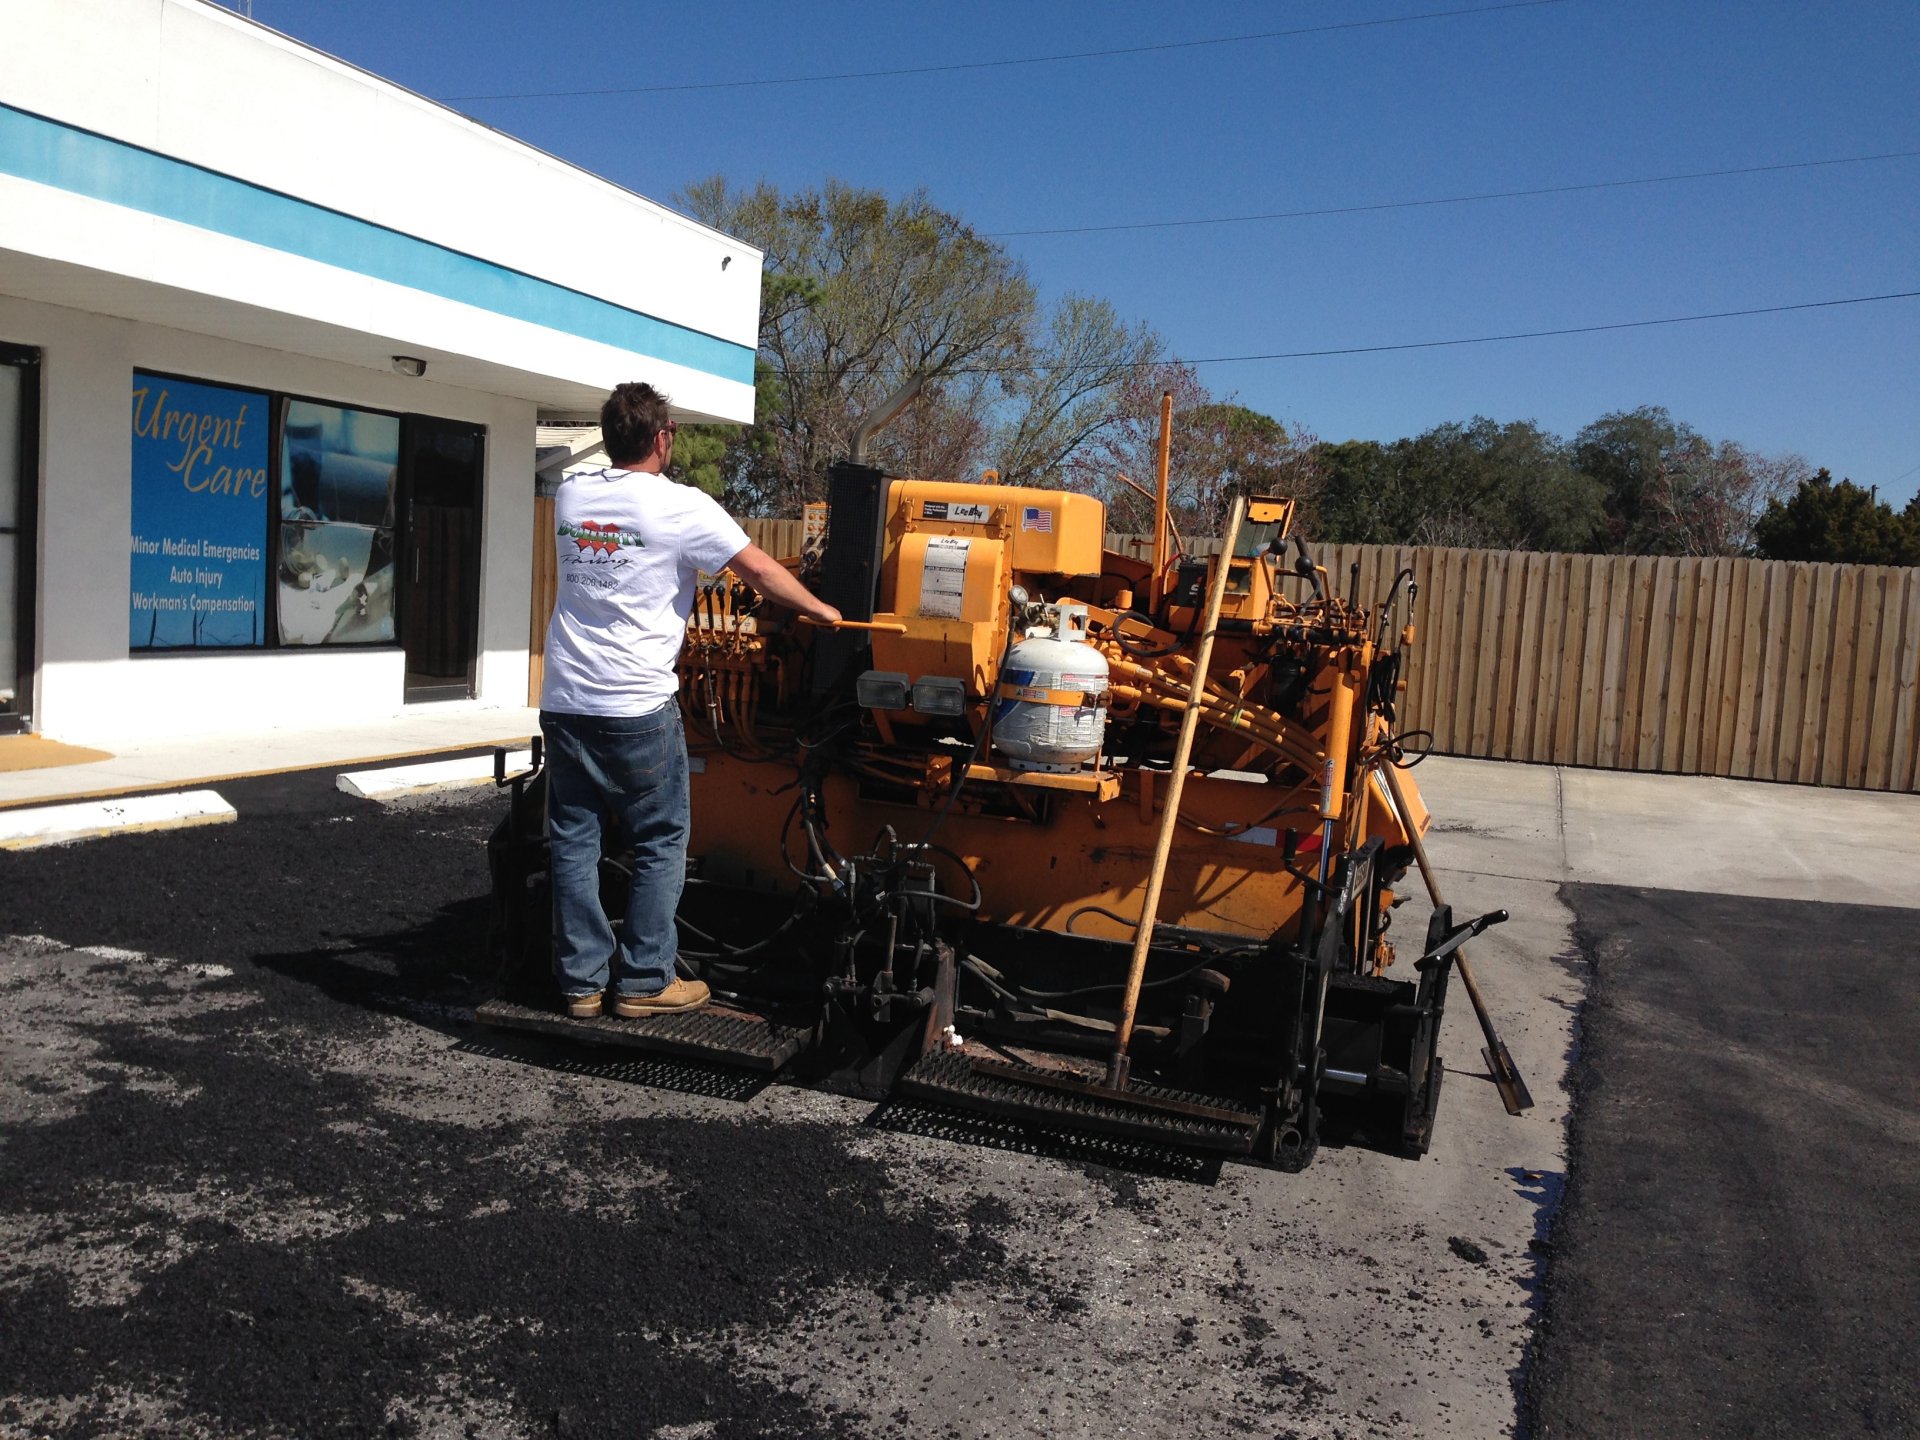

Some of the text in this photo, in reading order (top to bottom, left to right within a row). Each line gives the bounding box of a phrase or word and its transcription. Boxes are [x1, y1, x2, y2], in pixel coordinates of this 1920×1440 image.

[132, 387, 247, 472] Urgent
[183, 444, 267, 499] Care
[131, 535, 260, 563] Minor Medical Emergencies
[169, 565, 223, 589] Auto Injury
[132, 591, 255, 615] Workman's Compensation
